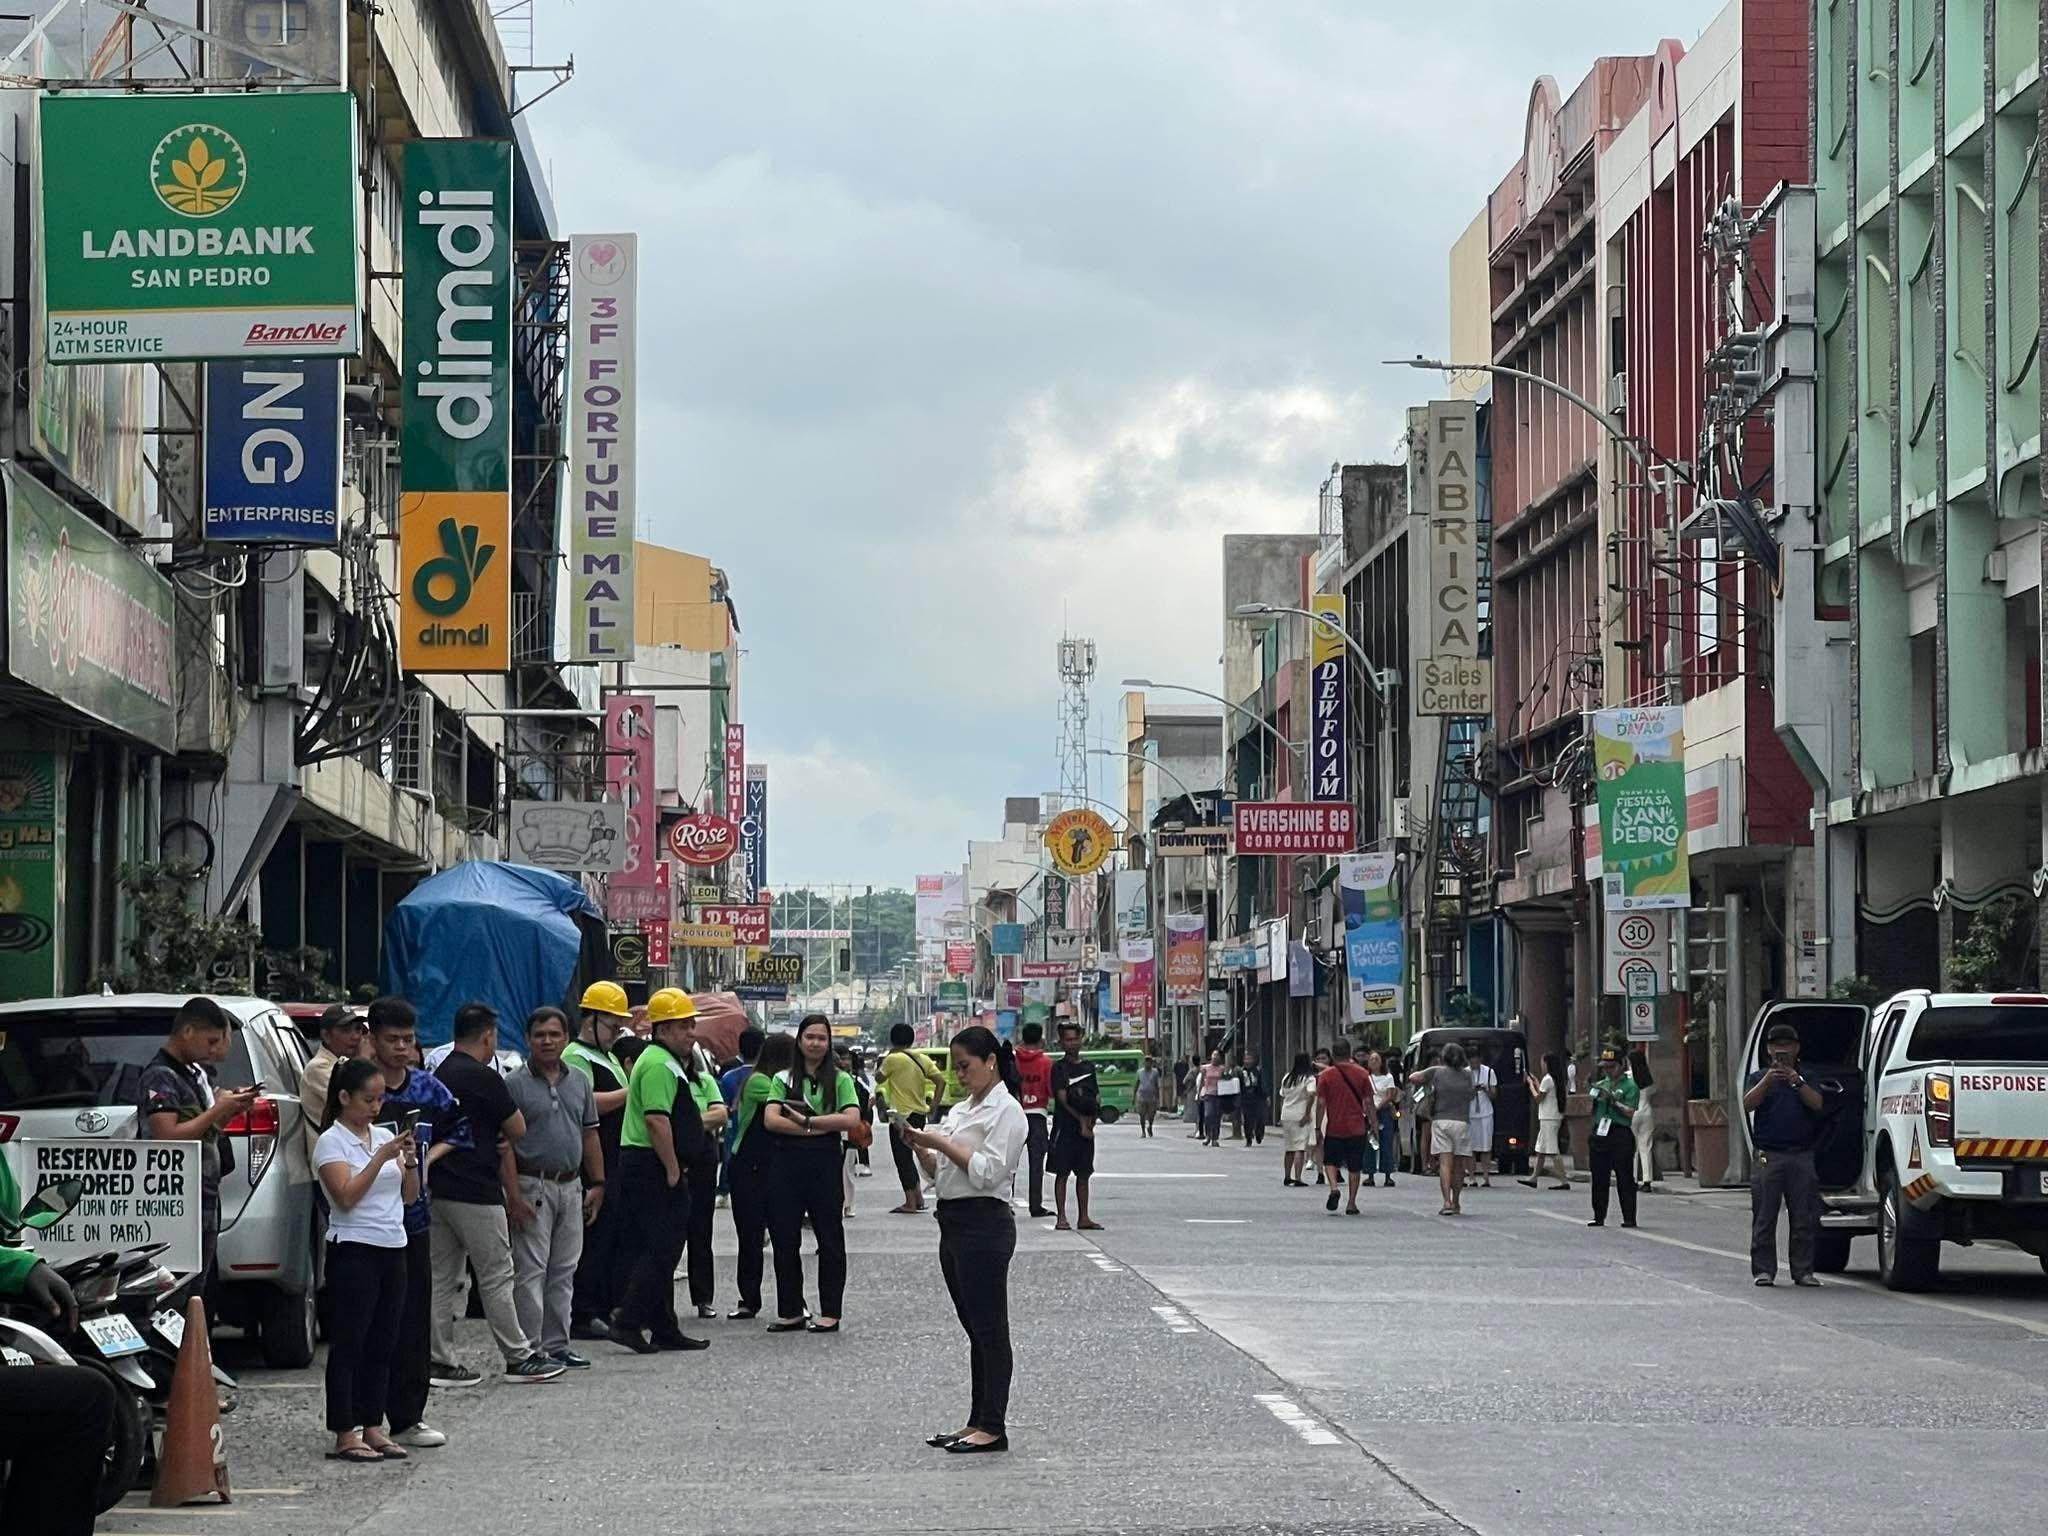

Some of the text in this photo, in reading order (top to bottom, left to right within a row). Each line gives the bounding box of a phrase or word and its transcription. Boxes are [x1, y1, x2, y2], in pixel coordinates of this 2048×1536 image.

[83, 226, 315, 259] LANDBANK
[132, 267, 271, 288] SAN PEDRO
[418, 190, 495, 440] dimdi
[54, 320, 127, 336] 24-HOUR
[250, 323, 347, 341] BancNet
[55, 338, 163, 354] ATM SERVICE
[583, 360, 621, 538] FORTUNE
[207, 506, 335, 525] ENTERPRISES
[1438, 416, 1470, 647] FABRICA
[583, 554, 620, 654] MALL
[418, 624, 490, 647] dimdi
[1425, 664, 1482, 687] Sales
[1422, 687, 1488, 712] Center
[1317, 662, 1342, 797] DEWFOAM
[1617, 721, 1664, 736] DAVAO
[1617, 795, 1672, 807] FIESTA SA
[1240, 809, 1350, 832] EVERSHINE 88
[1621, 806, 1666, 826] SAN
[676, 824, 728, 852] Rose
[1159, 833, 1227, 847] DOWNTOWN
[1245, 835, 1345, 848] CORPORATION
[1613, 825, 1679, 847] PEDRO
[692, 886, 719, 898] LEON
[1625, 924, 1650, 941] 30
[1961, 1075, 2046, 1092] RESPONSE
[37, 1148, 184, 1171] RESERVED FOR
[143, 1174, 184, 1195] CAR
[110, 1200, 128, 1216] OFF
[136, 1200, 184, 1217] ENGINES
[84, 1224, 100, 1240] ON
[110, 1220, 151, 1242] PARK)
[210, 1423, 225, 1464] 2
